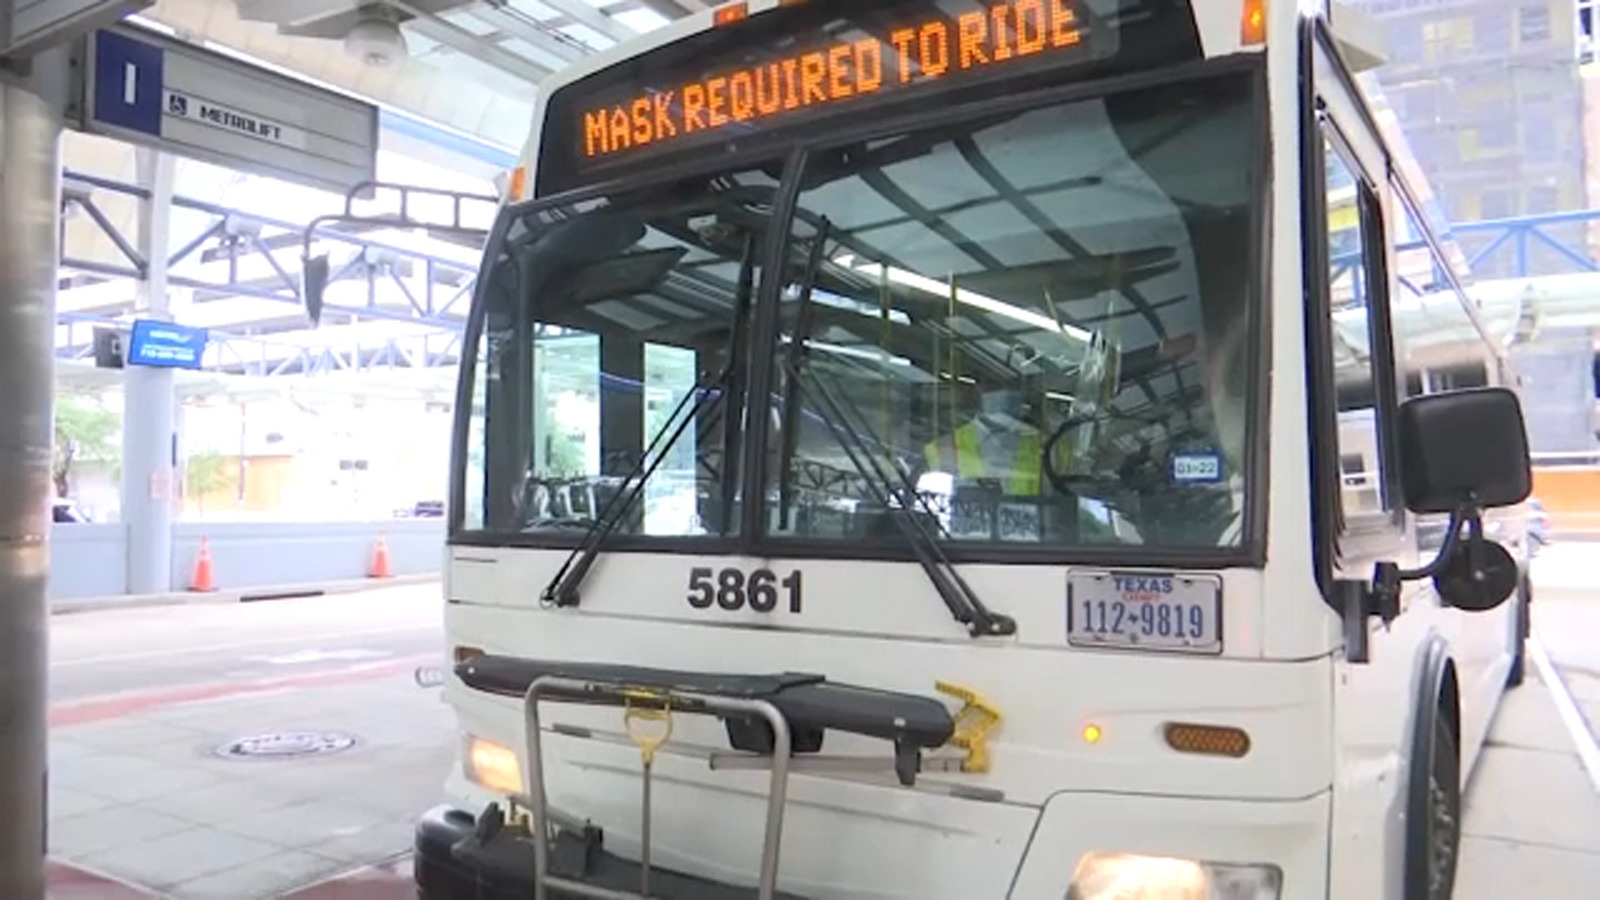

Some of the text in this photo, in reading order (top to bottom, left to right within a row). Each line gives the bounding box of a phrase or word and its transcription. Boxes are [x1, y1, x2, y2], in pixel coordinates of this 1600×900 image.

[583, 0, 1080, 156] MASK REQUIRED TO RIDE
[200, 105, 282, 140] METROLIFT
[686, 567, 803, 613] 5861
[1112, 577, 1174, 594] TEXAS
